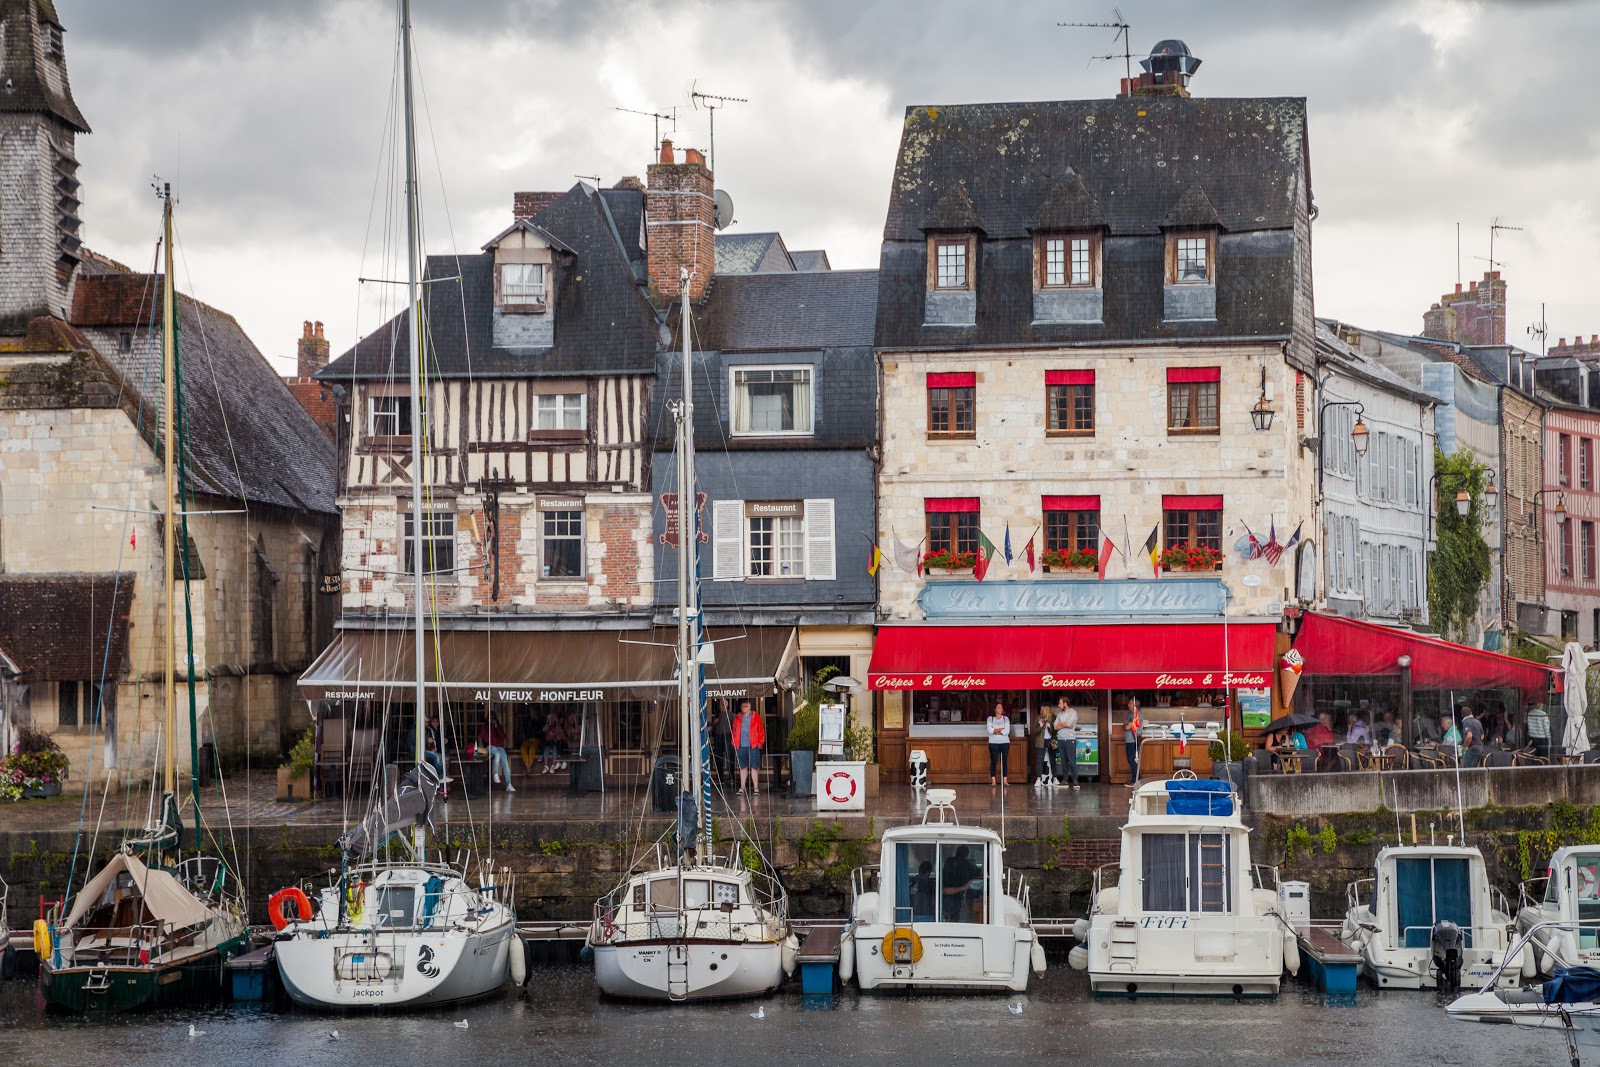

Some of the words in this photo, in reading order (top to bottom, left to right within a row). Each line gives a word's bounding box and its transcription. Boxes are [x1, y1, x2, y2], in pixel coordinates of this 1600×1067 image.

[540, 499, 583, 507] Restaurant
[753, 504, 797, 512] Restaurant
[944, 585, 986, 609] La
[997, 584, 1105, 609] Maison
[1120, 584, 1206, 608] Bleue
[875, 675, 914, 689] Crêpes
[923, 675, 933, 686] &
[941, 675, 986, 689] Gaufres
[1041, 674, 1096, 687] Brasserie
[1155, 674, 1193, 689] Glaces
[1202, 673, 1213, 685] &
[1221, 673, 1265, 685] Sorbets
[325, 691, 375, 699] RESTAURANT
[474, 690, 491, 700] AU
[498, 690, 533, 701] VIEUX
[540, 690, 604, 700] HONFLEUR
[1140, 915, 1189, 929] FiFi
[352, 989, 384, 998] jackpot
